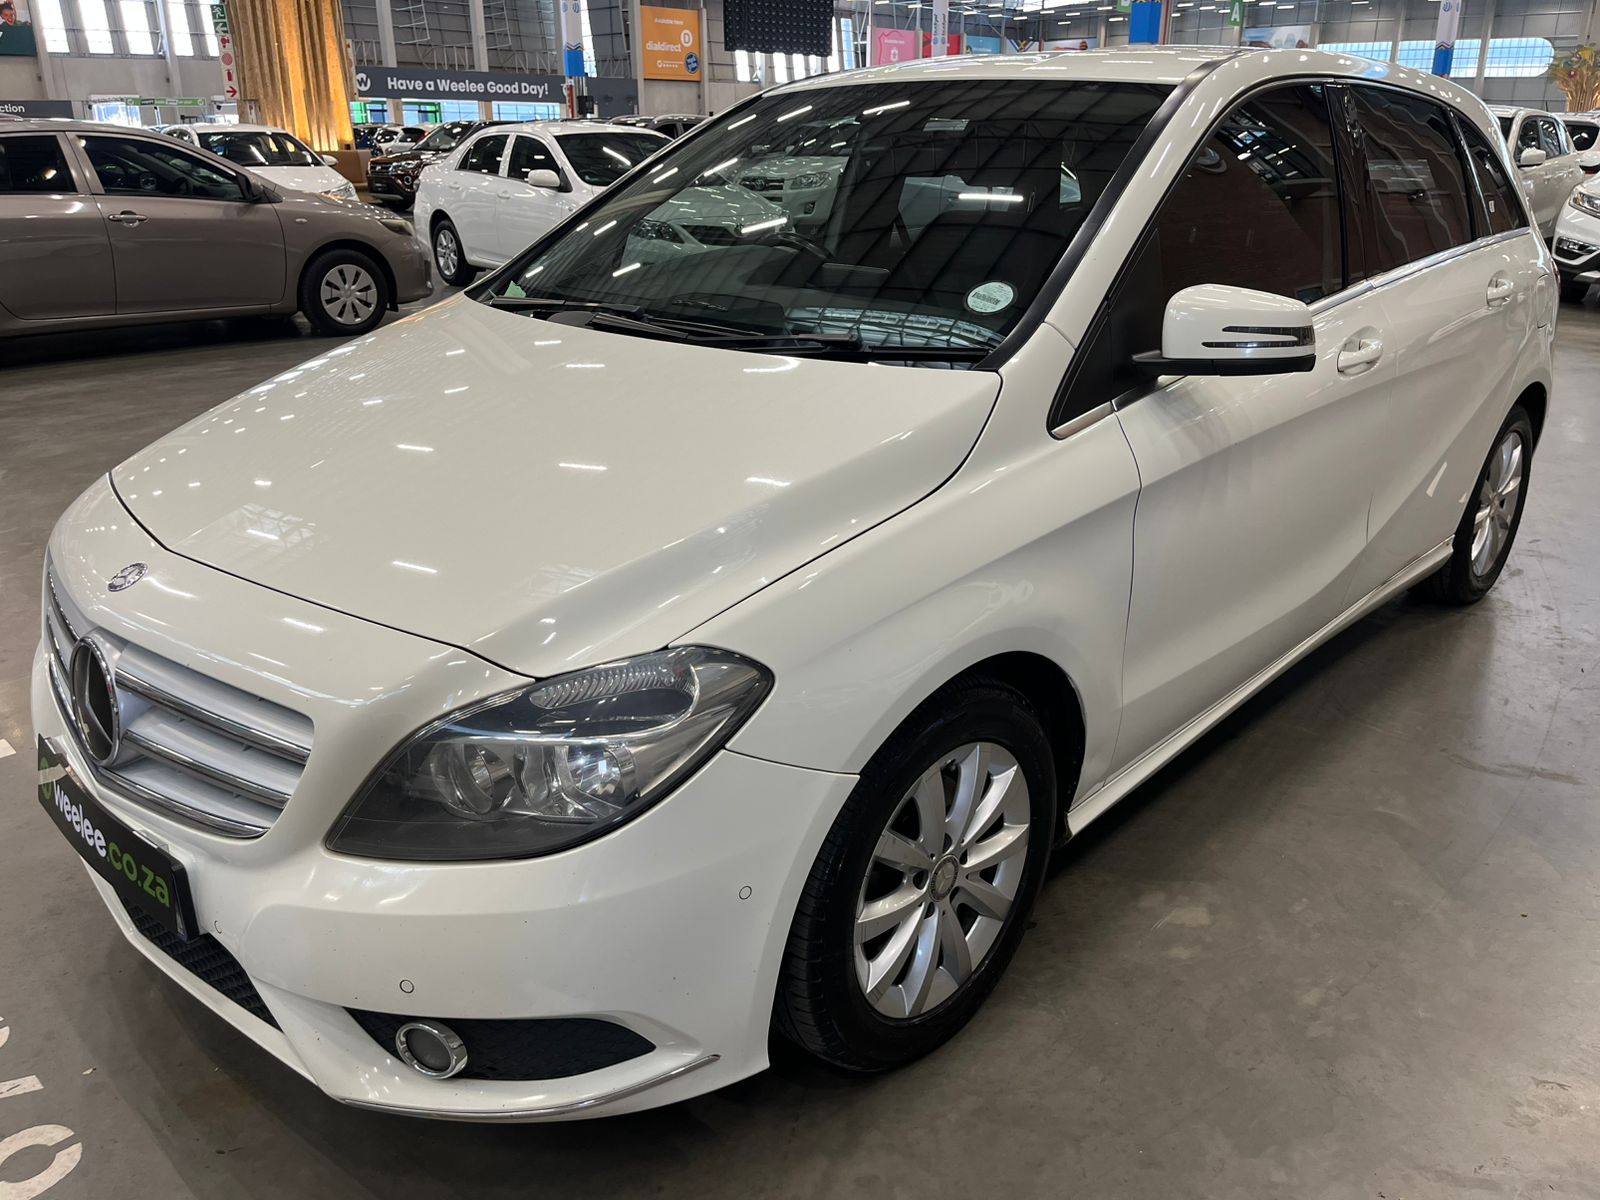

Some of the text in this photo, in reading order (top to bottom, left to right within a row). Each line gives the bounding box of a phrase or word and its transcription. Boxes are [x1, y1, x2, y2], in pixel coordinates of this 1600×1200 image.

[1231, 2, 1240, 21] A
[387, 77, 549, 98] Have a Weelee Good Day!
[53, 779, 170, 908] weelee.co.za
